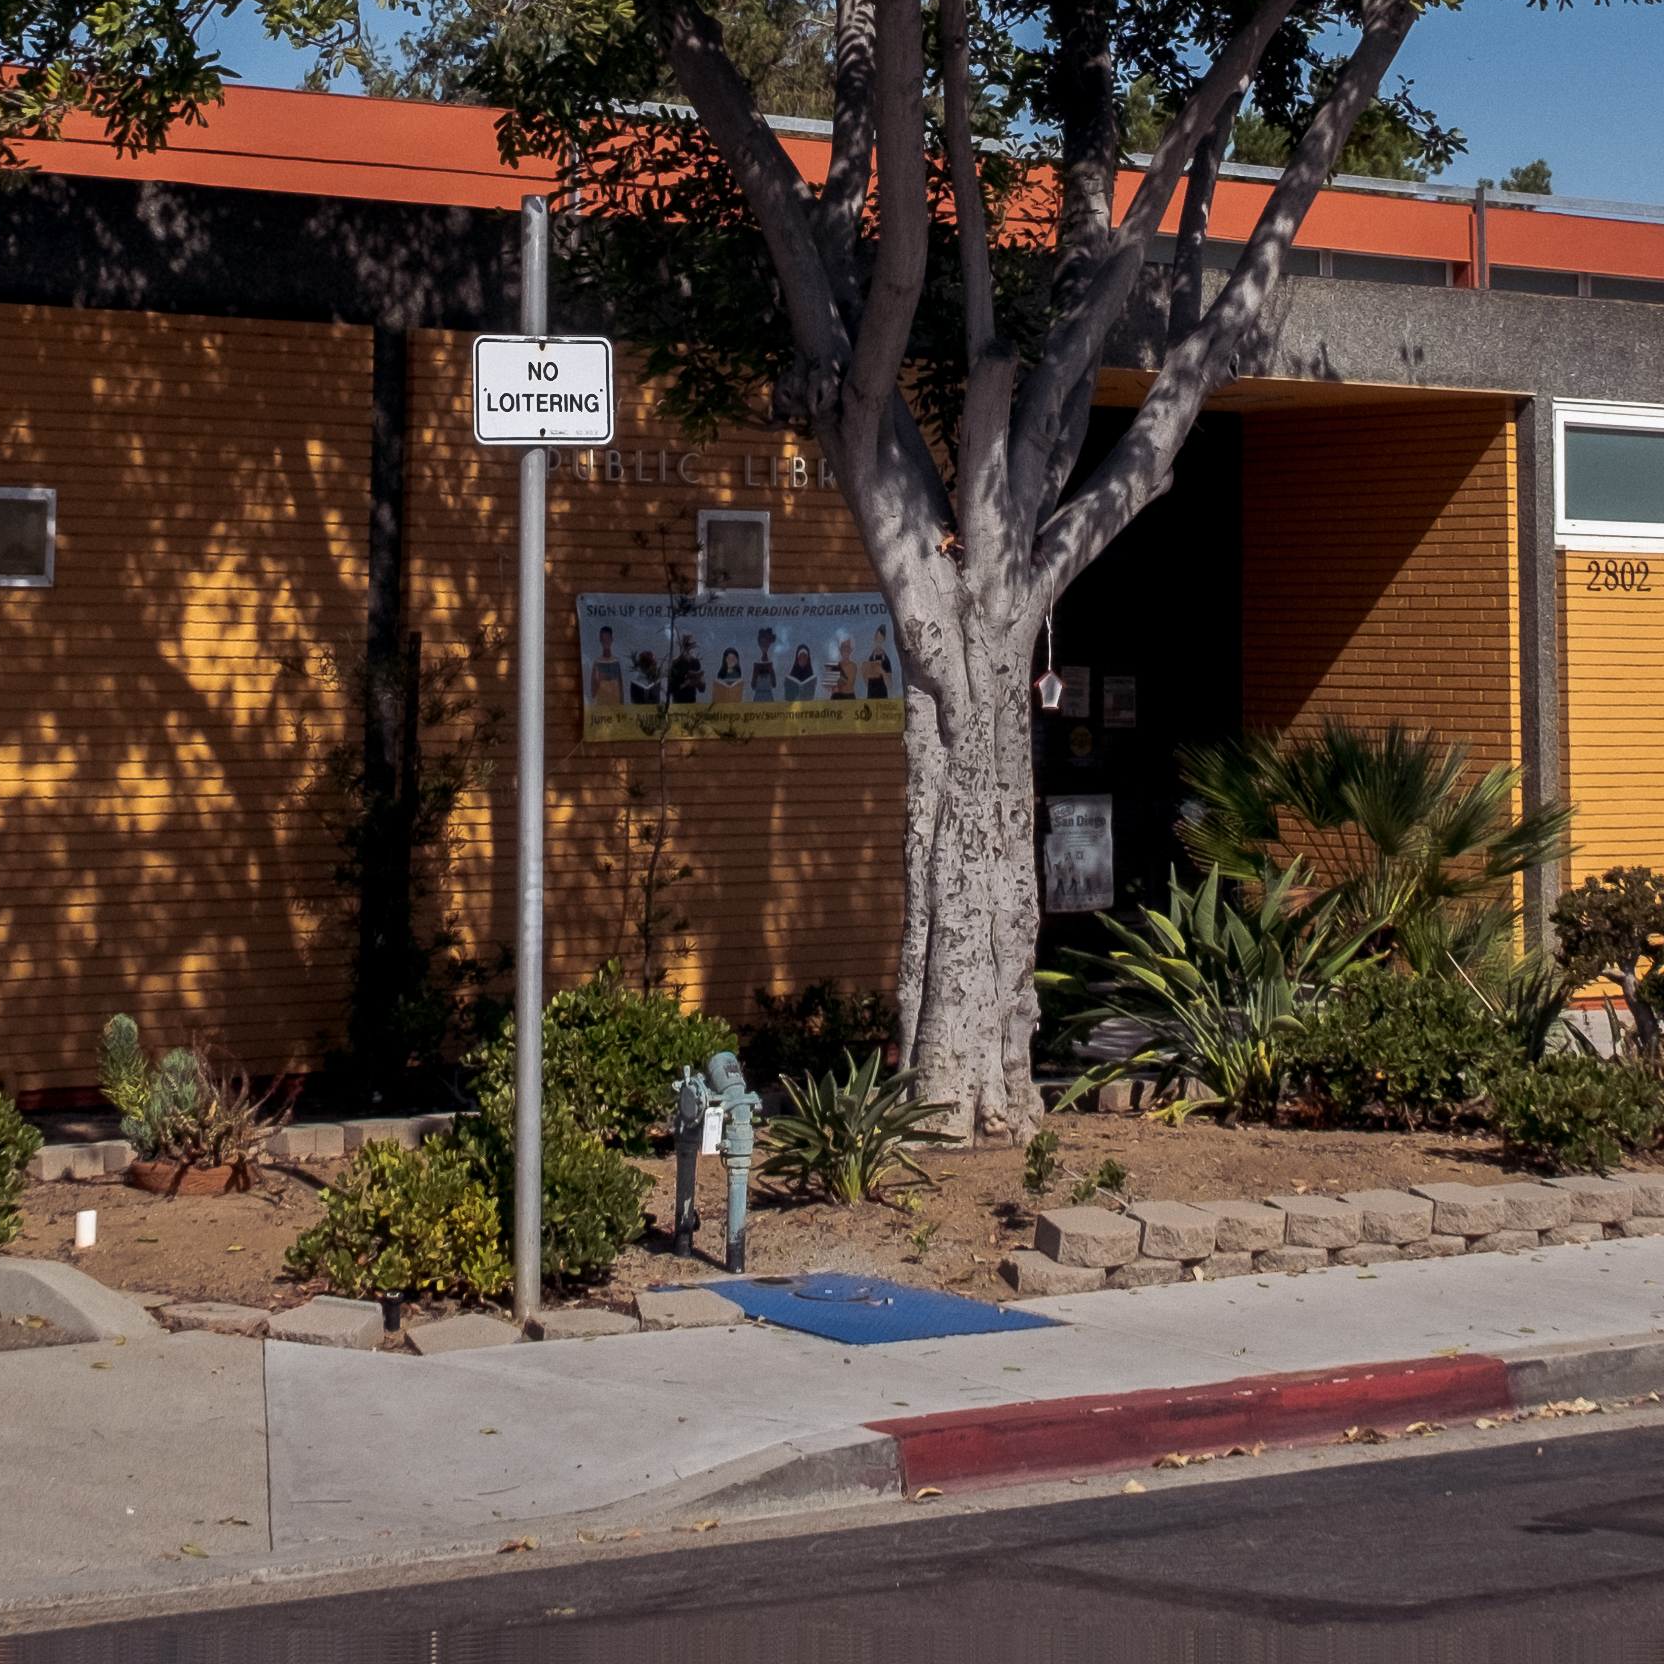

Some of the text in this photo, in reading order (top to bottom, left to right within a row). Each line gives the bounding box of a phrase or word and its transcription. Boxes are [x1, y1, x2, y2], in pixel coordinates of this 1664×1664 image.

[528, 361, 559, 382] NO
[487, 392, 600, 413] LOITERING
[545, 446, 703, 486] PUBLIC
[1586, 559, 1652, 592] 2802
[586, 604, 616, 617] SIGN
[619, 605, 635, 617] UP
[639, 605, 663, 617] FOR
[691, 605, 744, 617] SUMMER
[746, 604, 799, 617] READING
[801, 604, 860, 616] PROGRAM
[590, 713, 613, 727] June
[1054, 814, 1106, 829] San Diego
